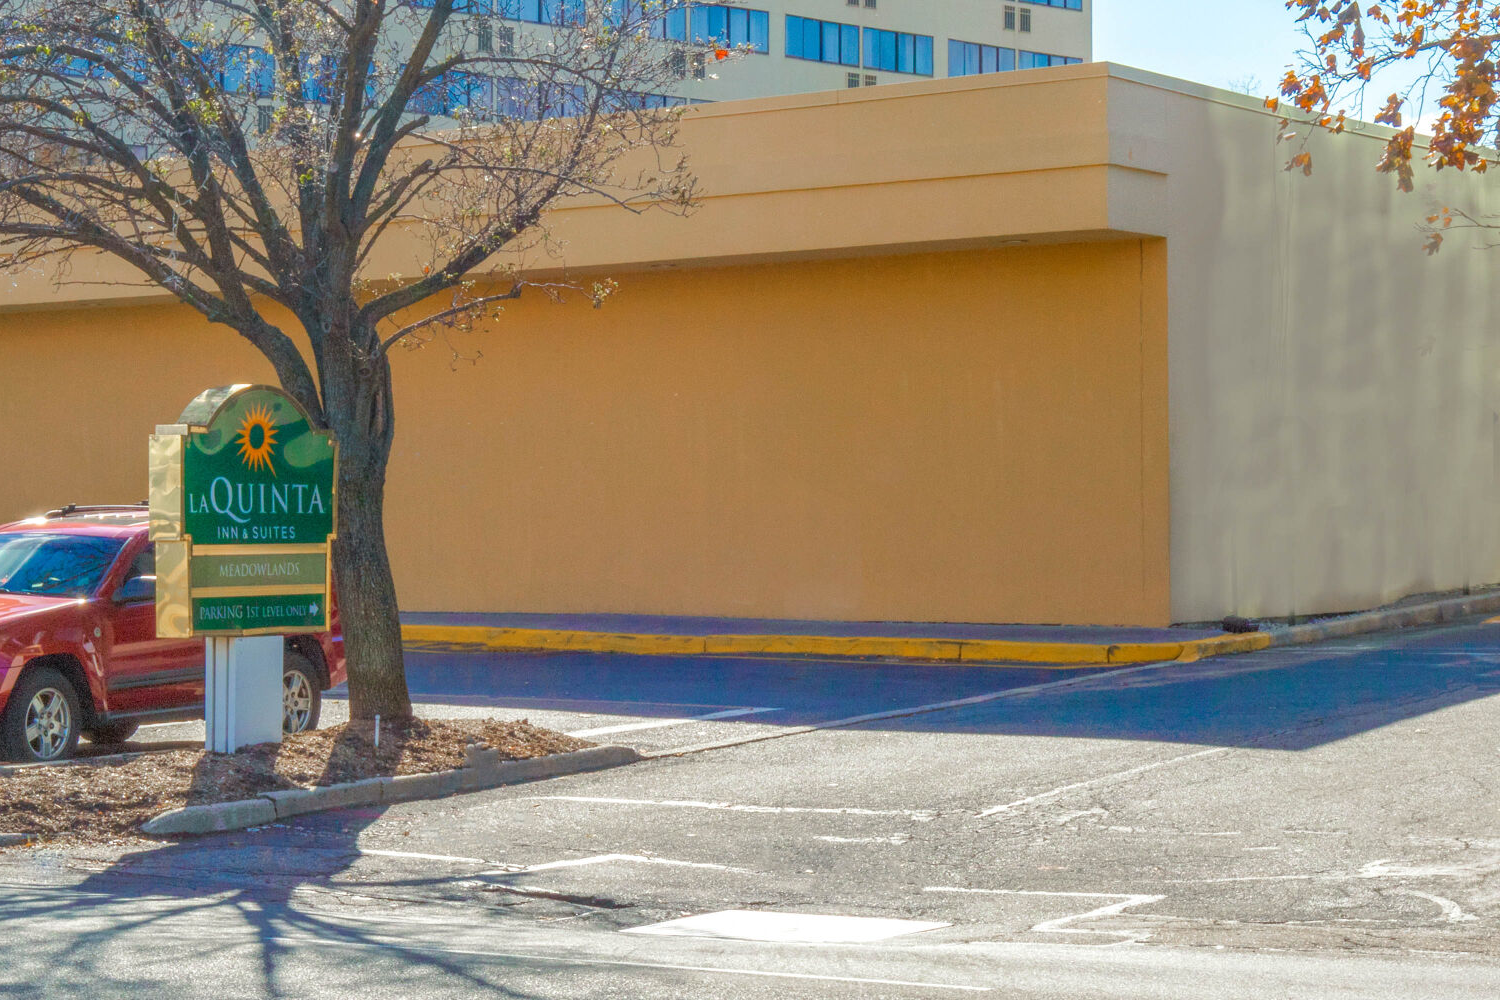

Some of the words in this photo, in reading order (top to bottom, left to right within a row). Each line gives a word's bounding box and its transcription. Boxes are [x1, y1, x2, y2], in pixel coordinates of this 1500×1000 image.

[210, 476, 326, 523] QUINTA
[217, 526, 238, 539] INN
[242, 528, 248, 539] &
[252, 526, 296, 539] SUITES
[219, 562, 300, 577] MEADOWLANDS
[199, 604, 243, 620] PARKING
[262, 604, 284, 618] LEVEL
[285, 604, 307, 617] ONLY
